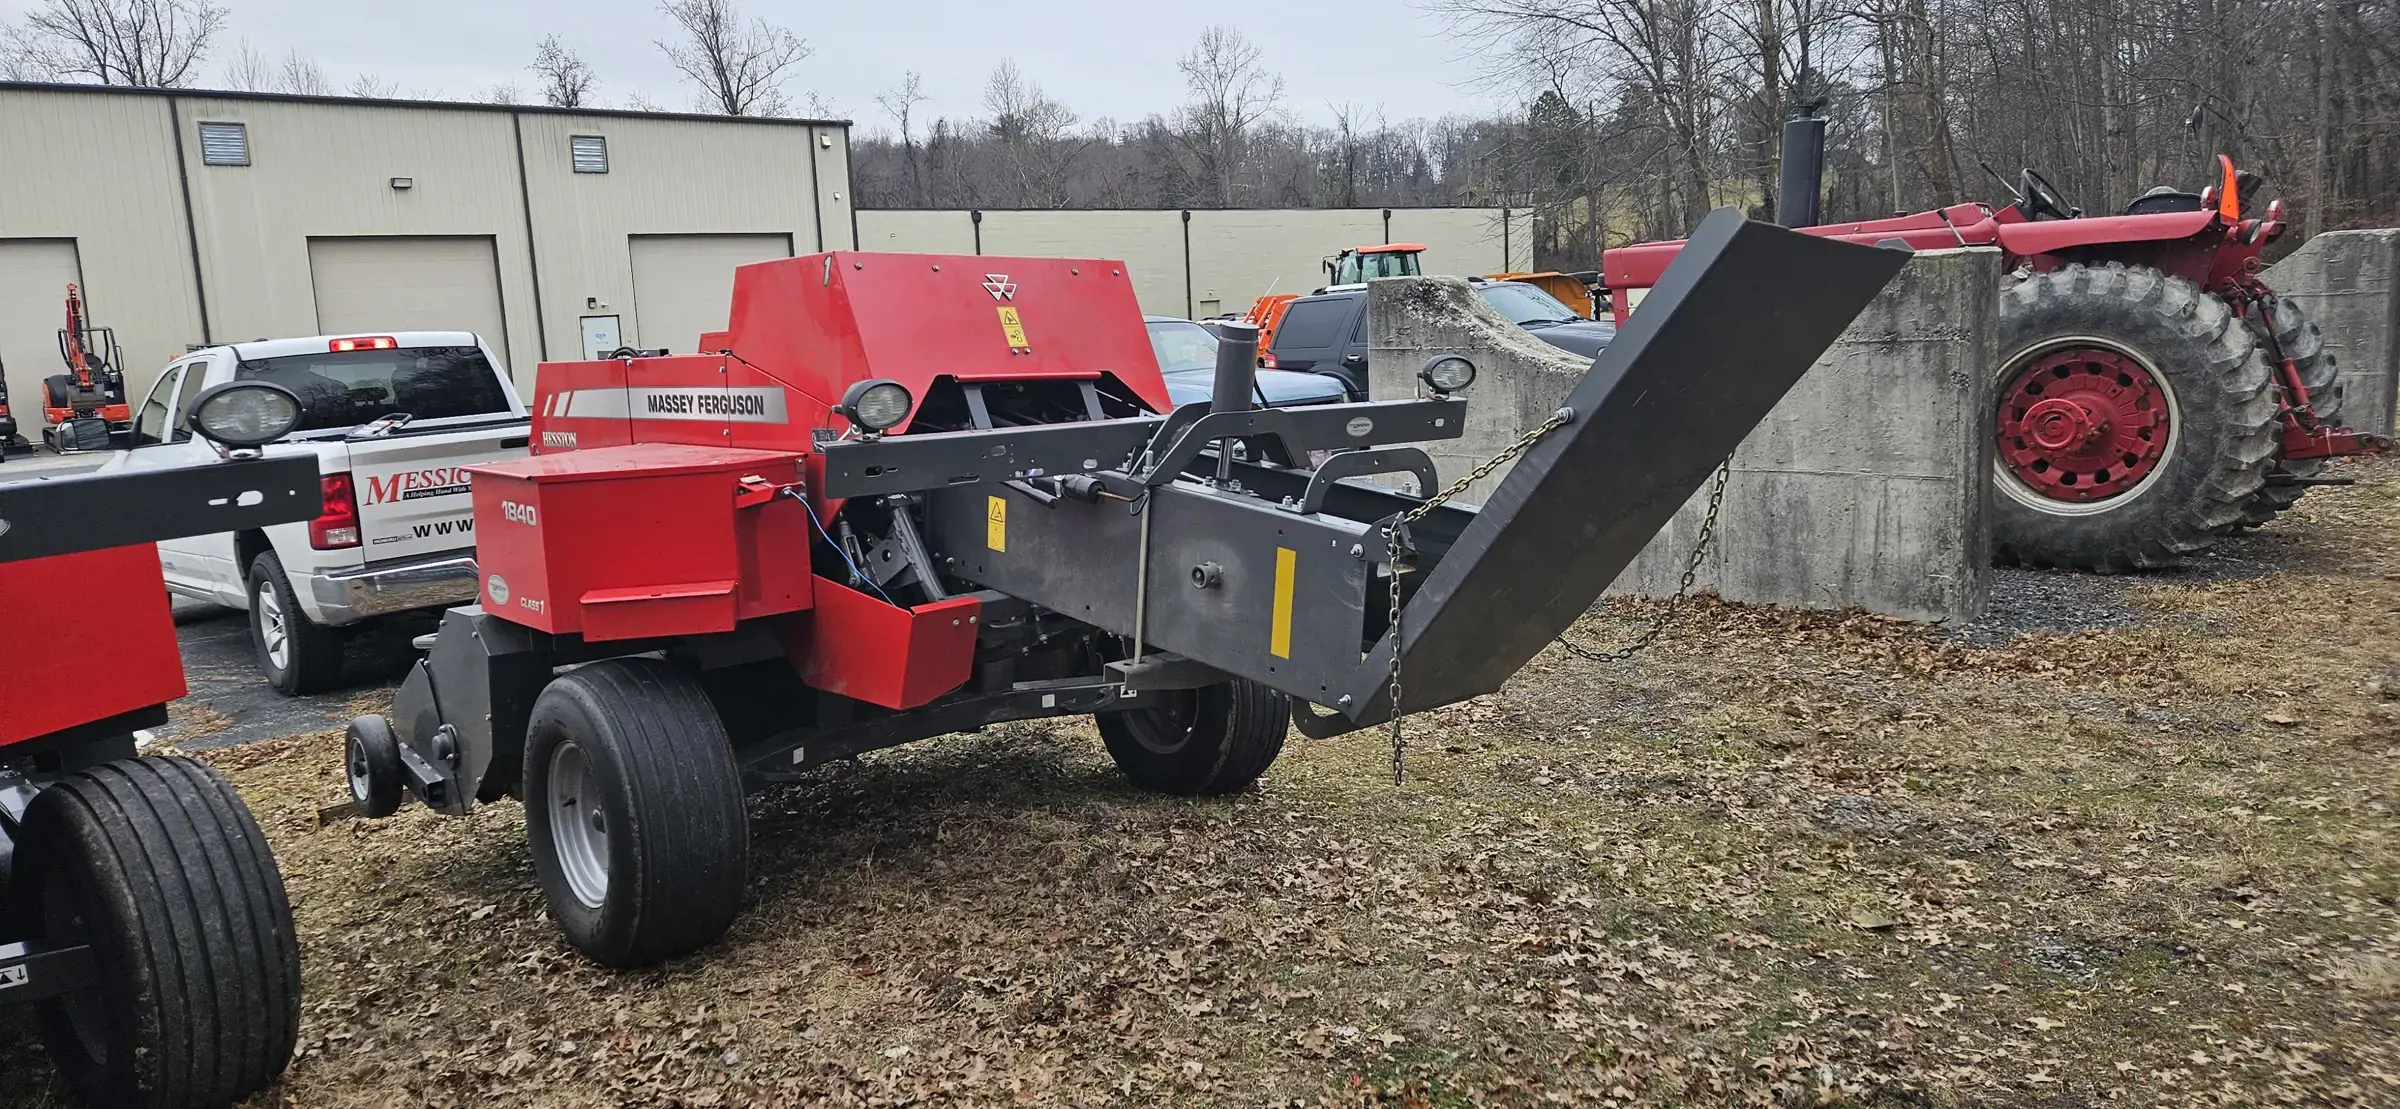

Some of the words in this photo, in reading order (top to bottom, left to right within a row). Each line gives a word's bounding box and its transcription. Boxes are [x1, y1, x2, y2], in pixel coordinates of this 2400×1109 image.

[647, 394, 693, 414] MASSEY
[698, 394, 764, 416] FERGUSON
[542, 431, 577, 448] HESSTON
[410, 488, 434, 498] Helping
[435, 487, 452, 496] Hand
[452, 485, 467, 493] With
[501, 500, 537, 526] 1840
